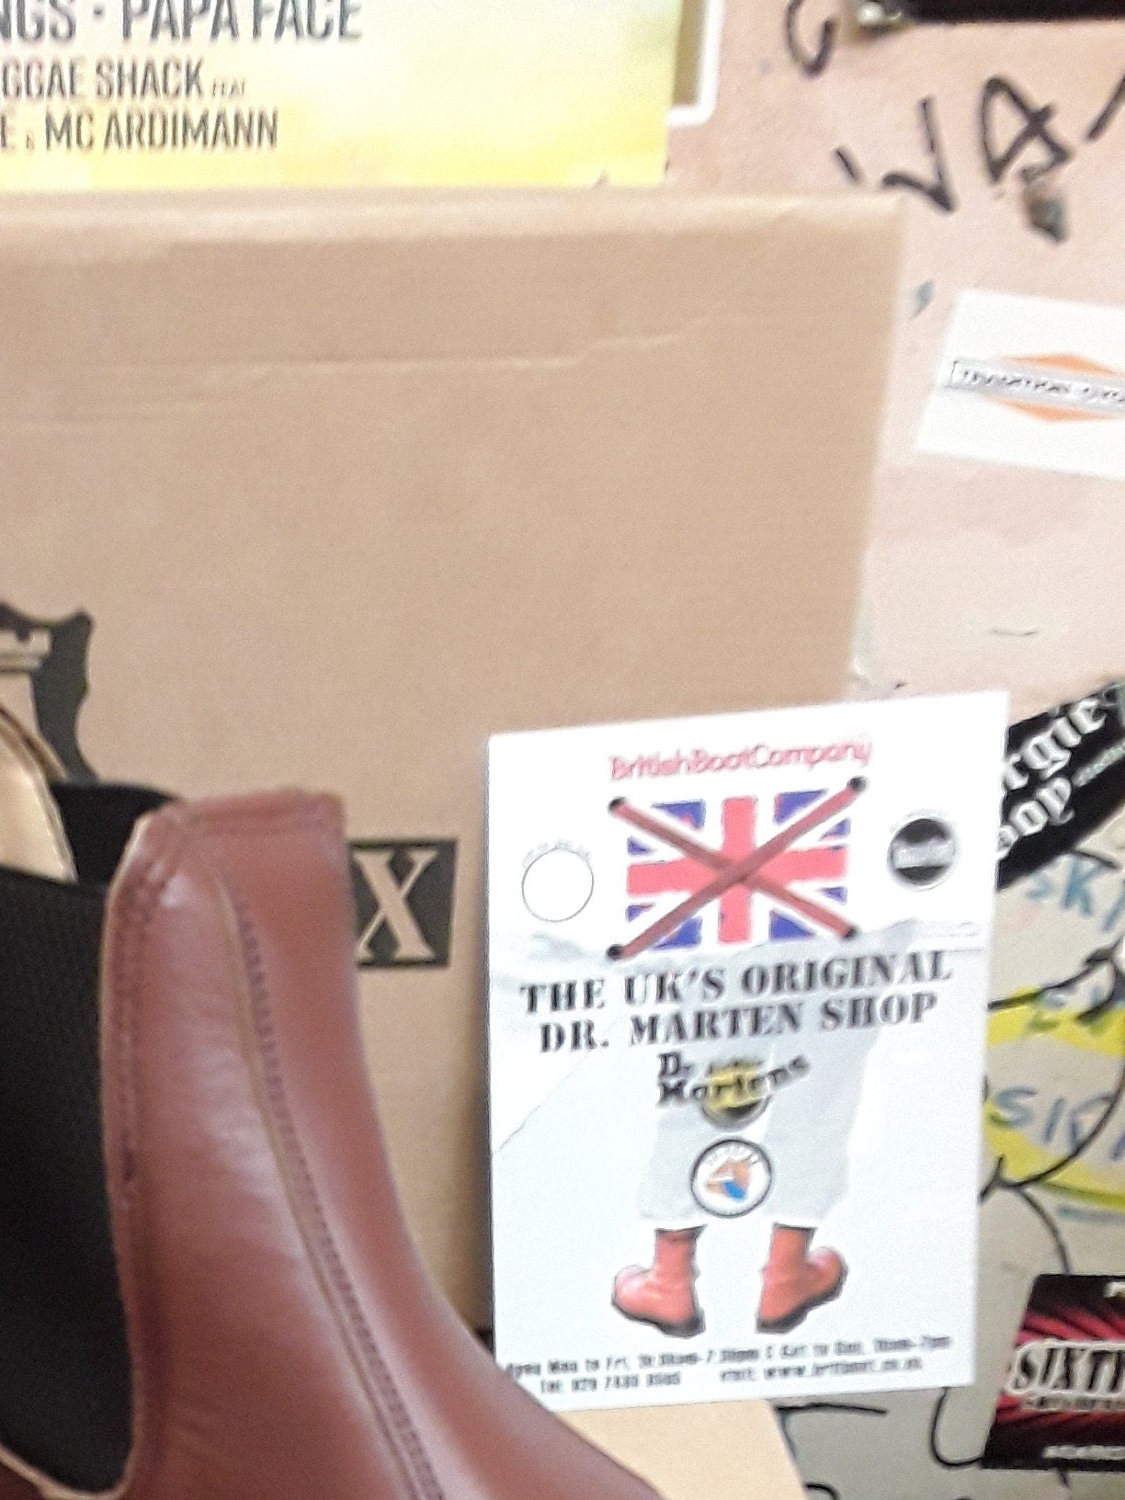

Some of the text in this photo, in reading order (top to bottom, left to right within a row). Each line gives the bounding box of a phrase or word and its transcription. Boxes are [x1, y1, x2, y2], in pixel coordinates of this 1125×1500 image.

[122, 0, 239, 41] PAPA
[251, 0, 363, 42] FACE
[95, 56, 203, 98] SHACK
[45, 108, 94, 150] MC
[103, 107, 278, 150] ARDIMANN
[519, 949, 954, 1014] THE UK'S ORIGINAL
[540, 991, 938, 1053] DR. MARTEN SHOP
